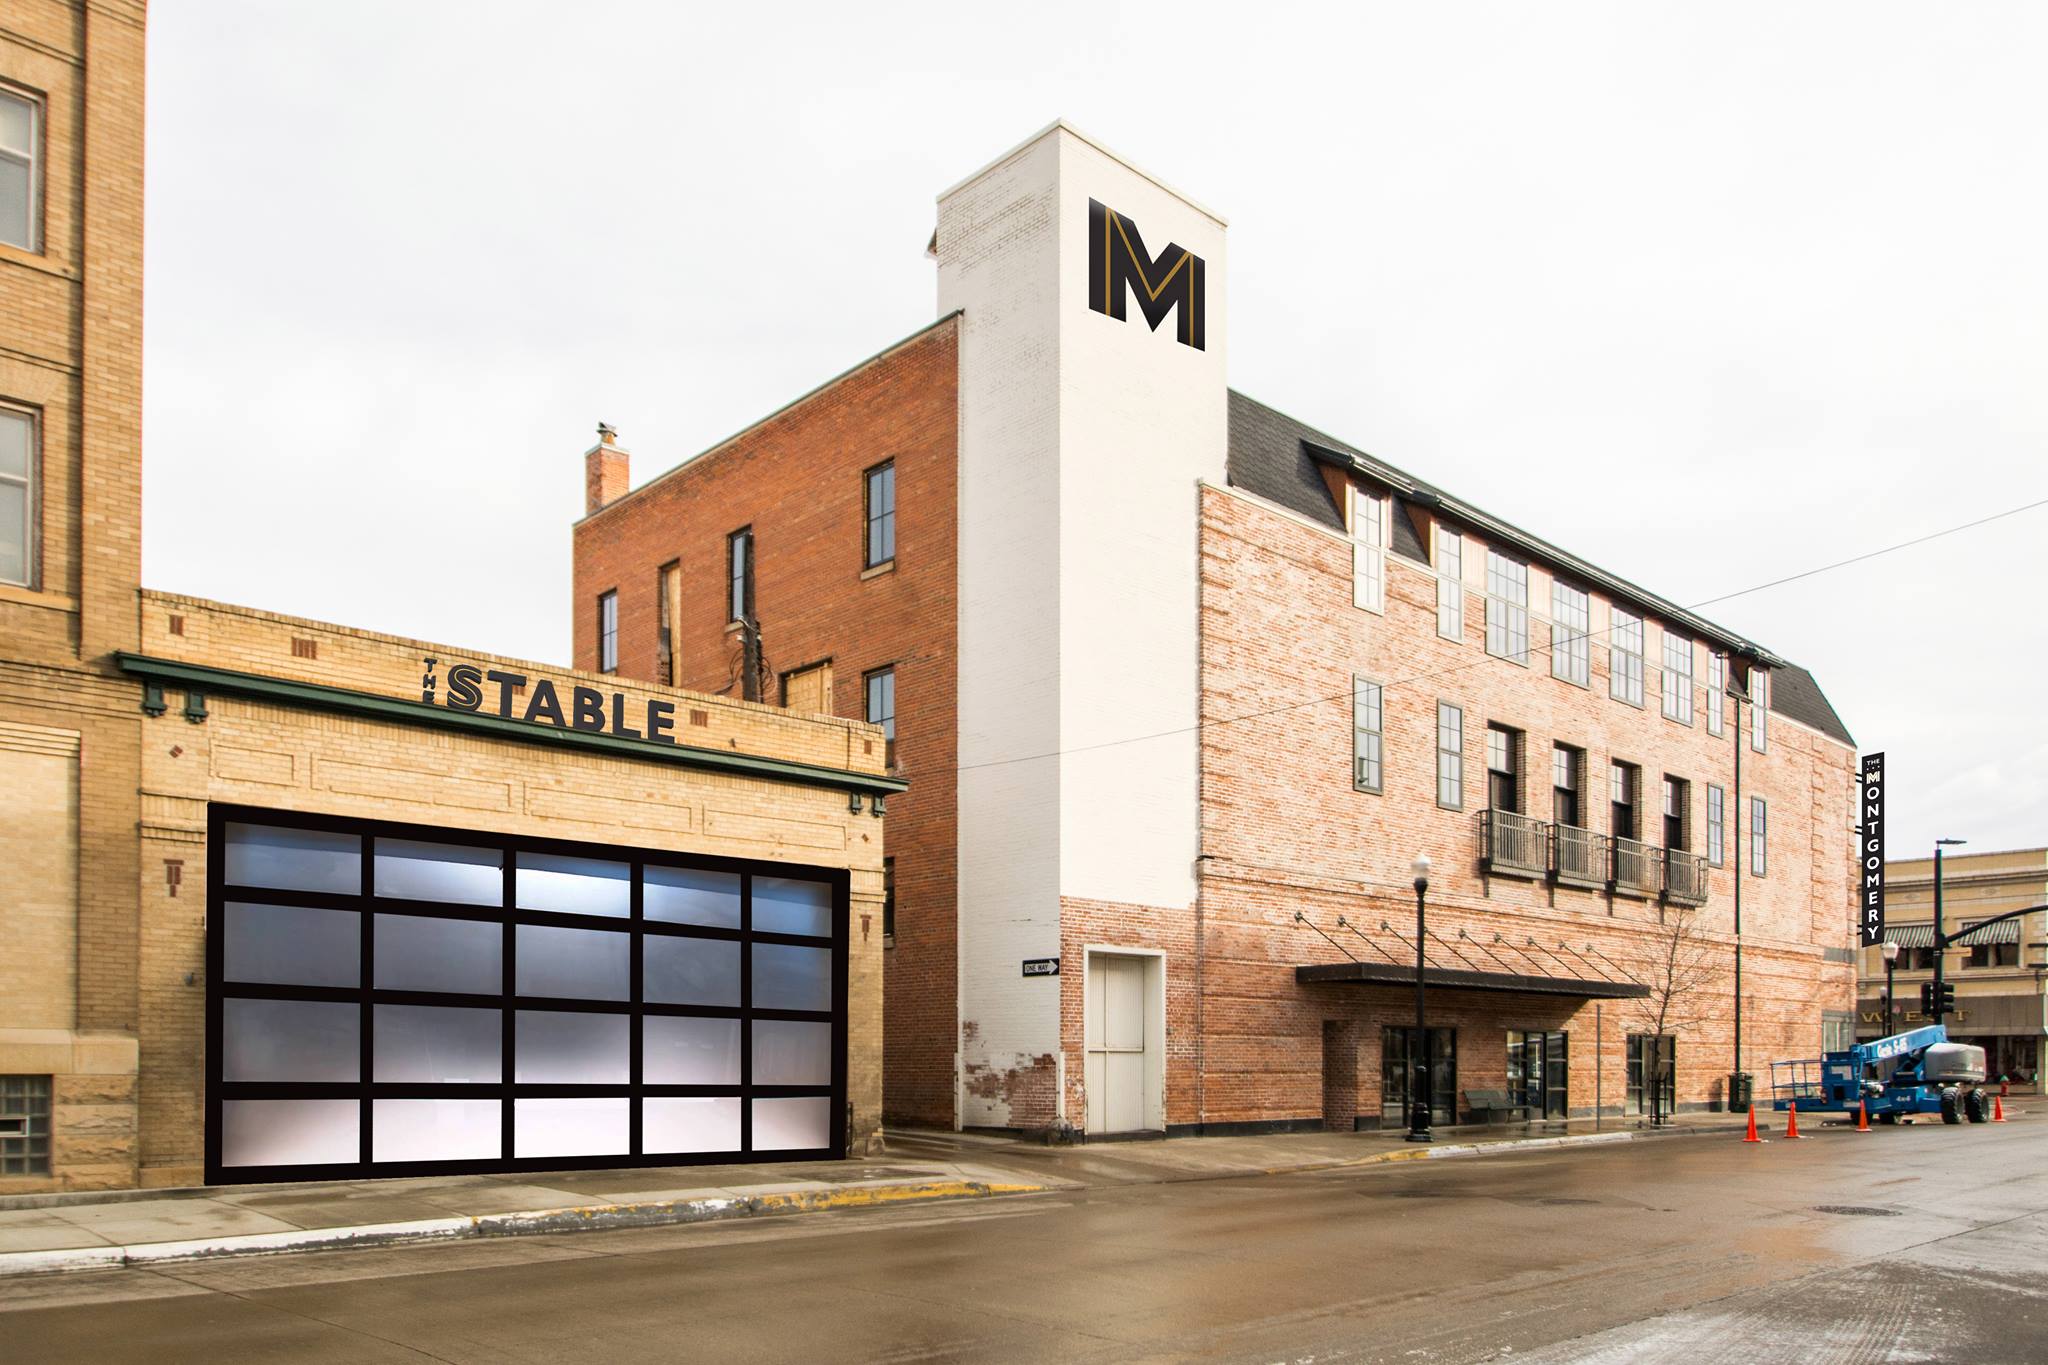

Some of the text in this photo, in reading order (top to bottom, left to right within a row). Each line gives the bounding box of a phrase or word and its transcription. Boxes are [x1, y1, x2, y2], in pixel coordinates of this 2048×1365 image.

[1088, 196, 1206, 352] M
[423, 657, 438, 705] THE
[447, 664, 675, 744] STABLE
[1866, 758, 1880, 766] THE
[1866, 770, 1880, 940] MONTGOMERY
[1025, 963, 1049, 972] ONE WAY
